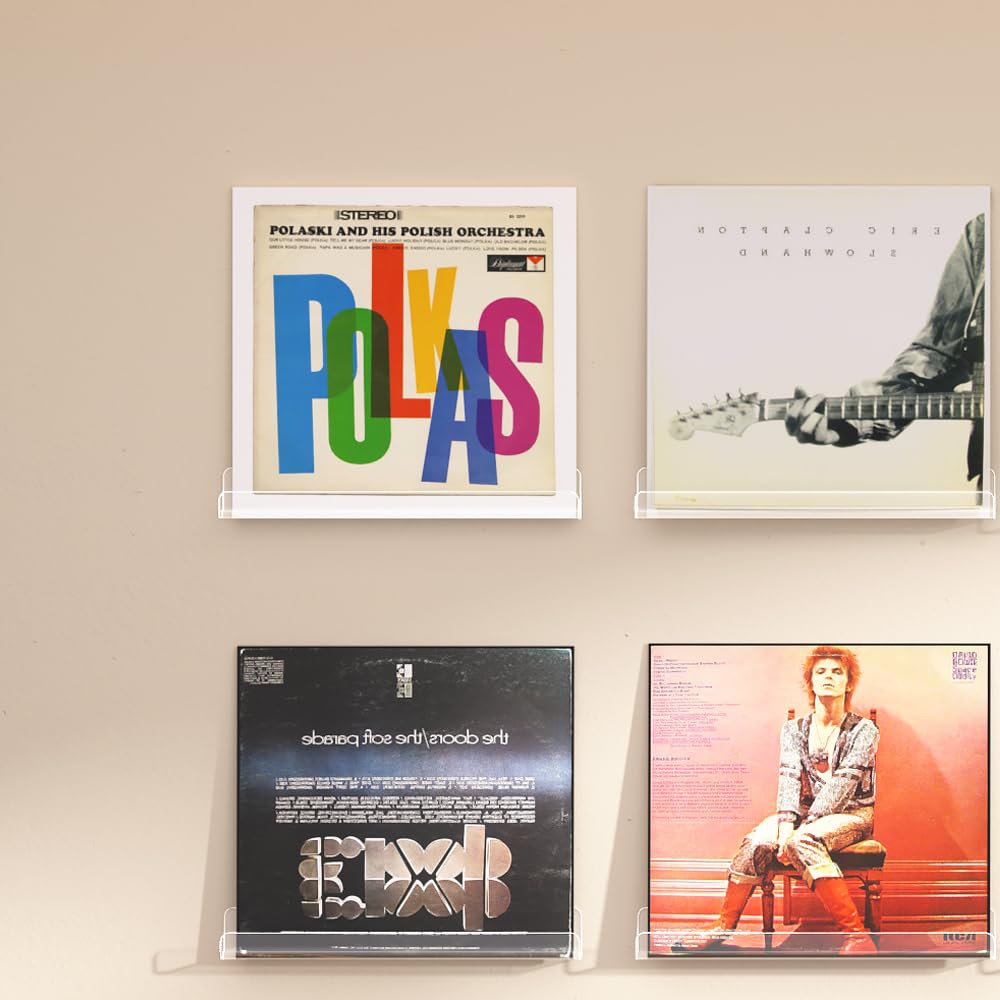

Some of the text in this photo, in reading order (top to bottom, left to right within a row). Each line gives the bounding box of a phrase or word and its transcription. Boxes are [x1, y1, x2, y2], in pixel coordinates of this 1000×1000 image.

[340, 210, 397, 220] STEREO
[269, 225, 545, 238] POLASKI AND HIS POLISH ORCHESTRA
[273, 243, 544, 485] POLKAS
